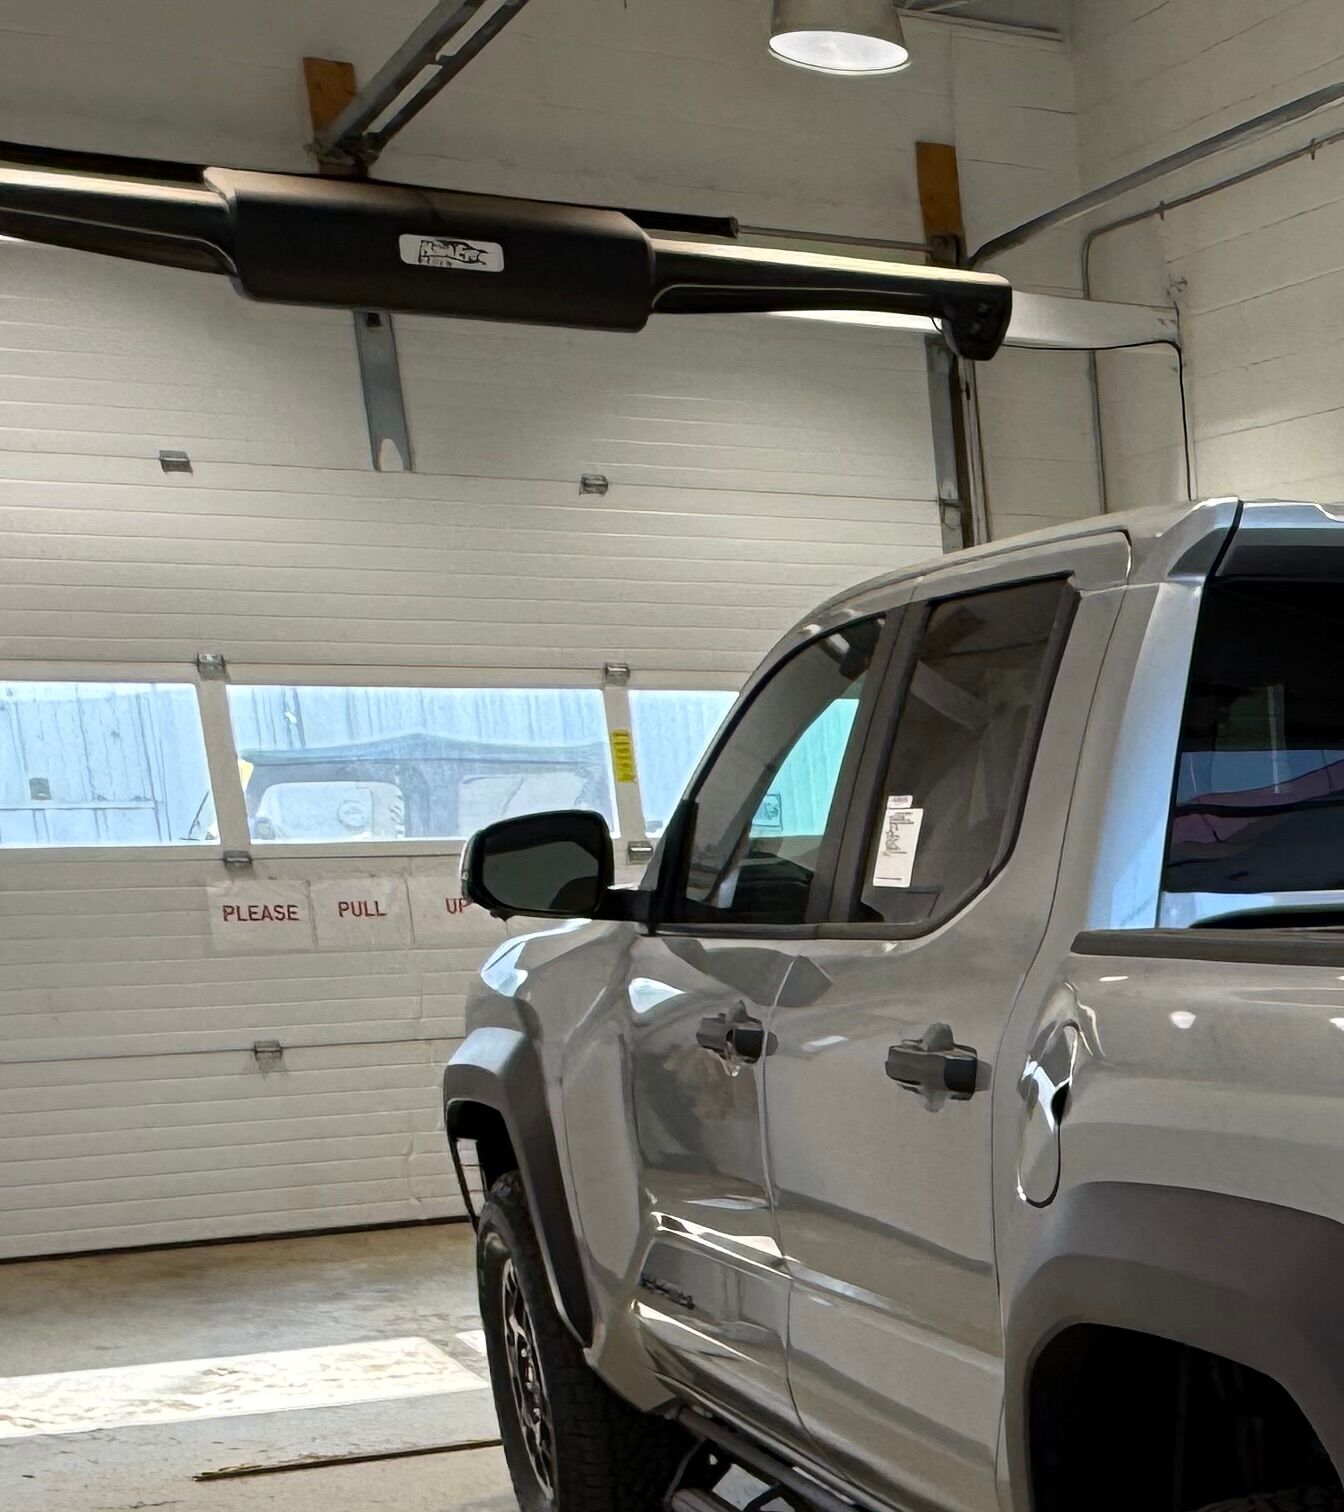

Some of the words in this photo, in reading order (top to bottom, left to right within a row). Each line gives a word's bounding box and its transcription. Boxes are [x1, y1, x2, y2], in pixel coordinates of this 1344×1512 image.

[222, 904, 300, 922] PLEASE
[337, 900, 387, 918] PULL
[445, 897, 472, 915] UP
